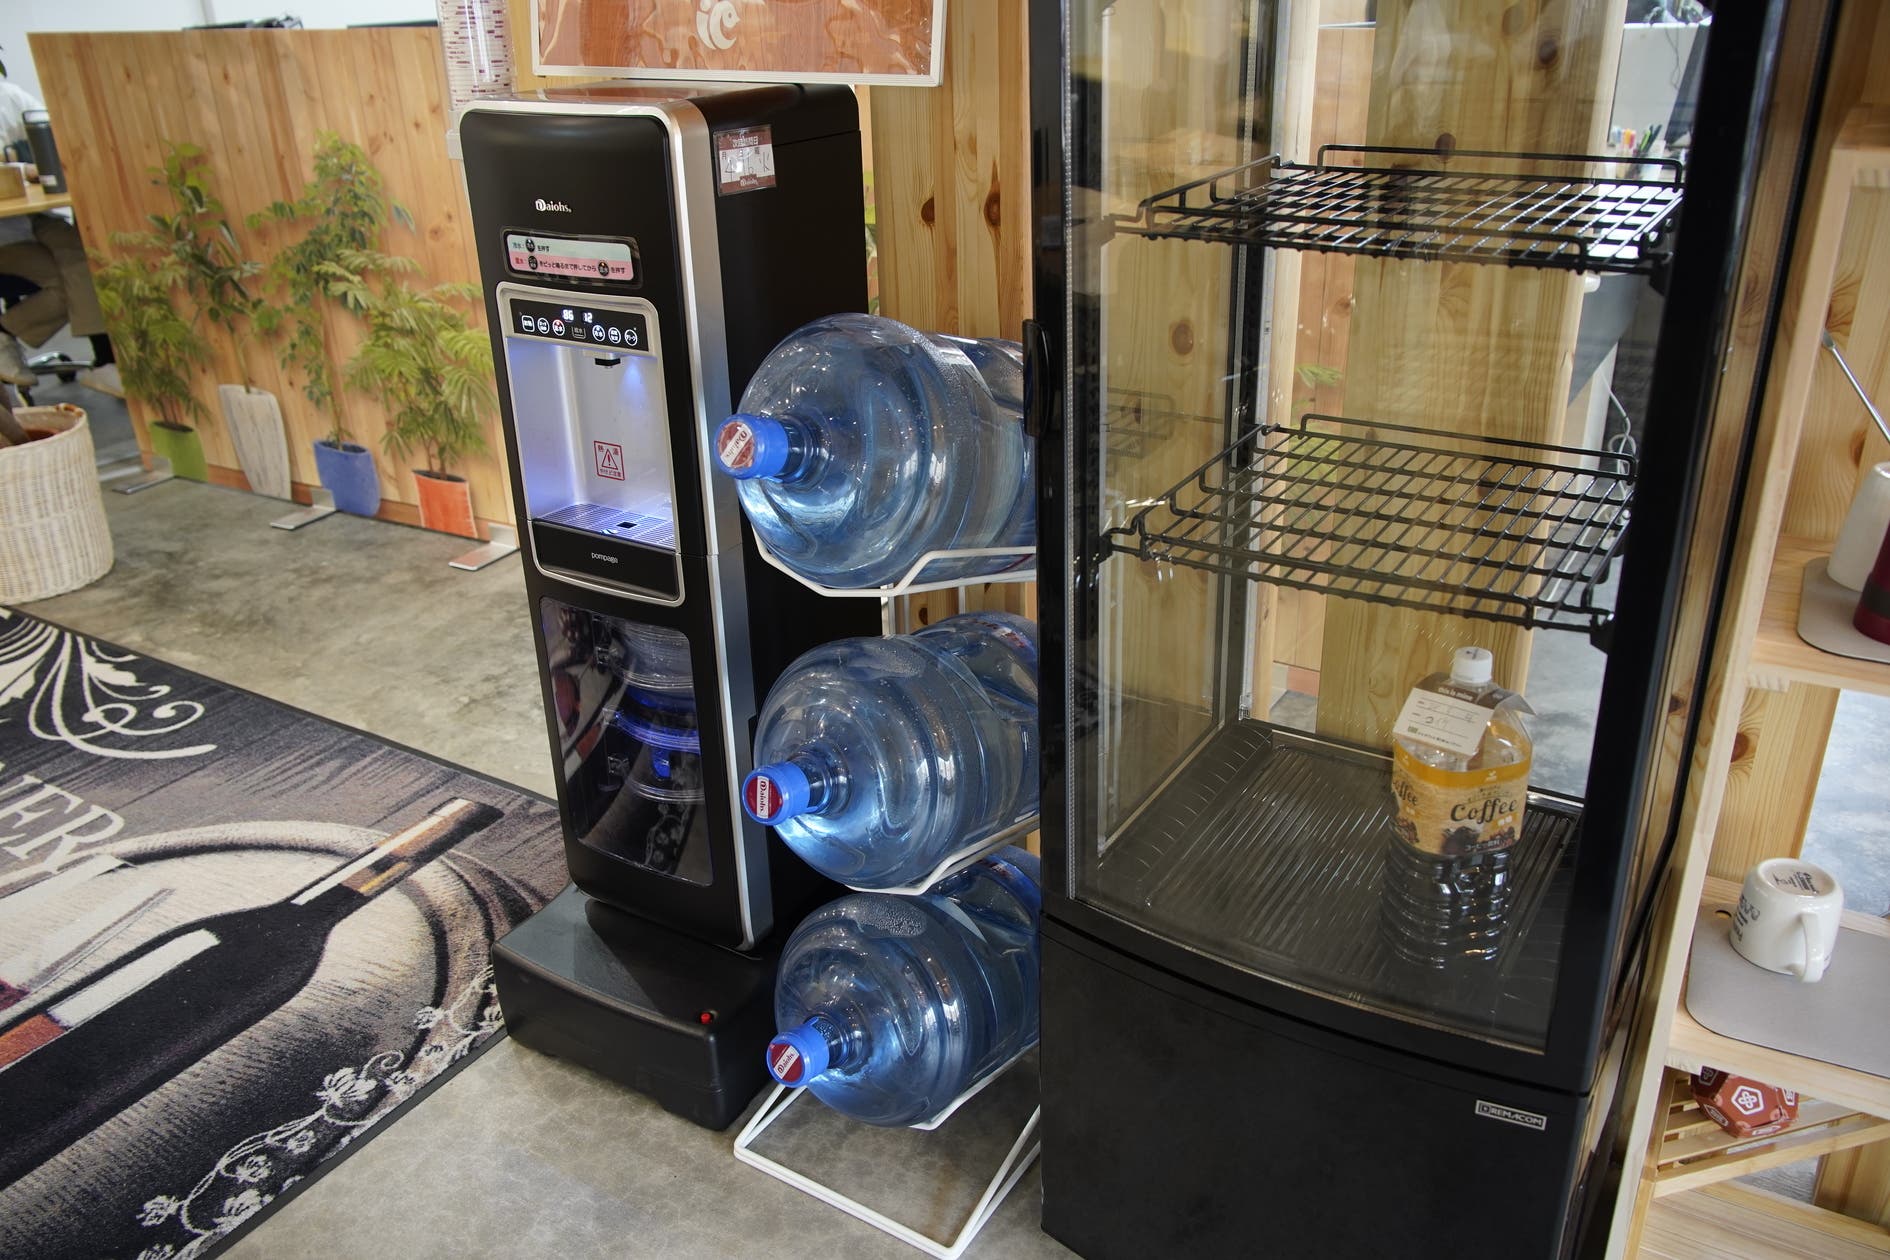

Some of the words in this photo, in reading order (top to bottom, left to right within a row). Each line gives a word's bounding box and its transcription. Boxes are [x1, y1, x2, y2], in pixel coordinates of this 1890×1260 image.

[583, 312, 593, 323] 12
[0, 774, 125, 875] ER
[1450, 797, 1518, 825] Coffee
